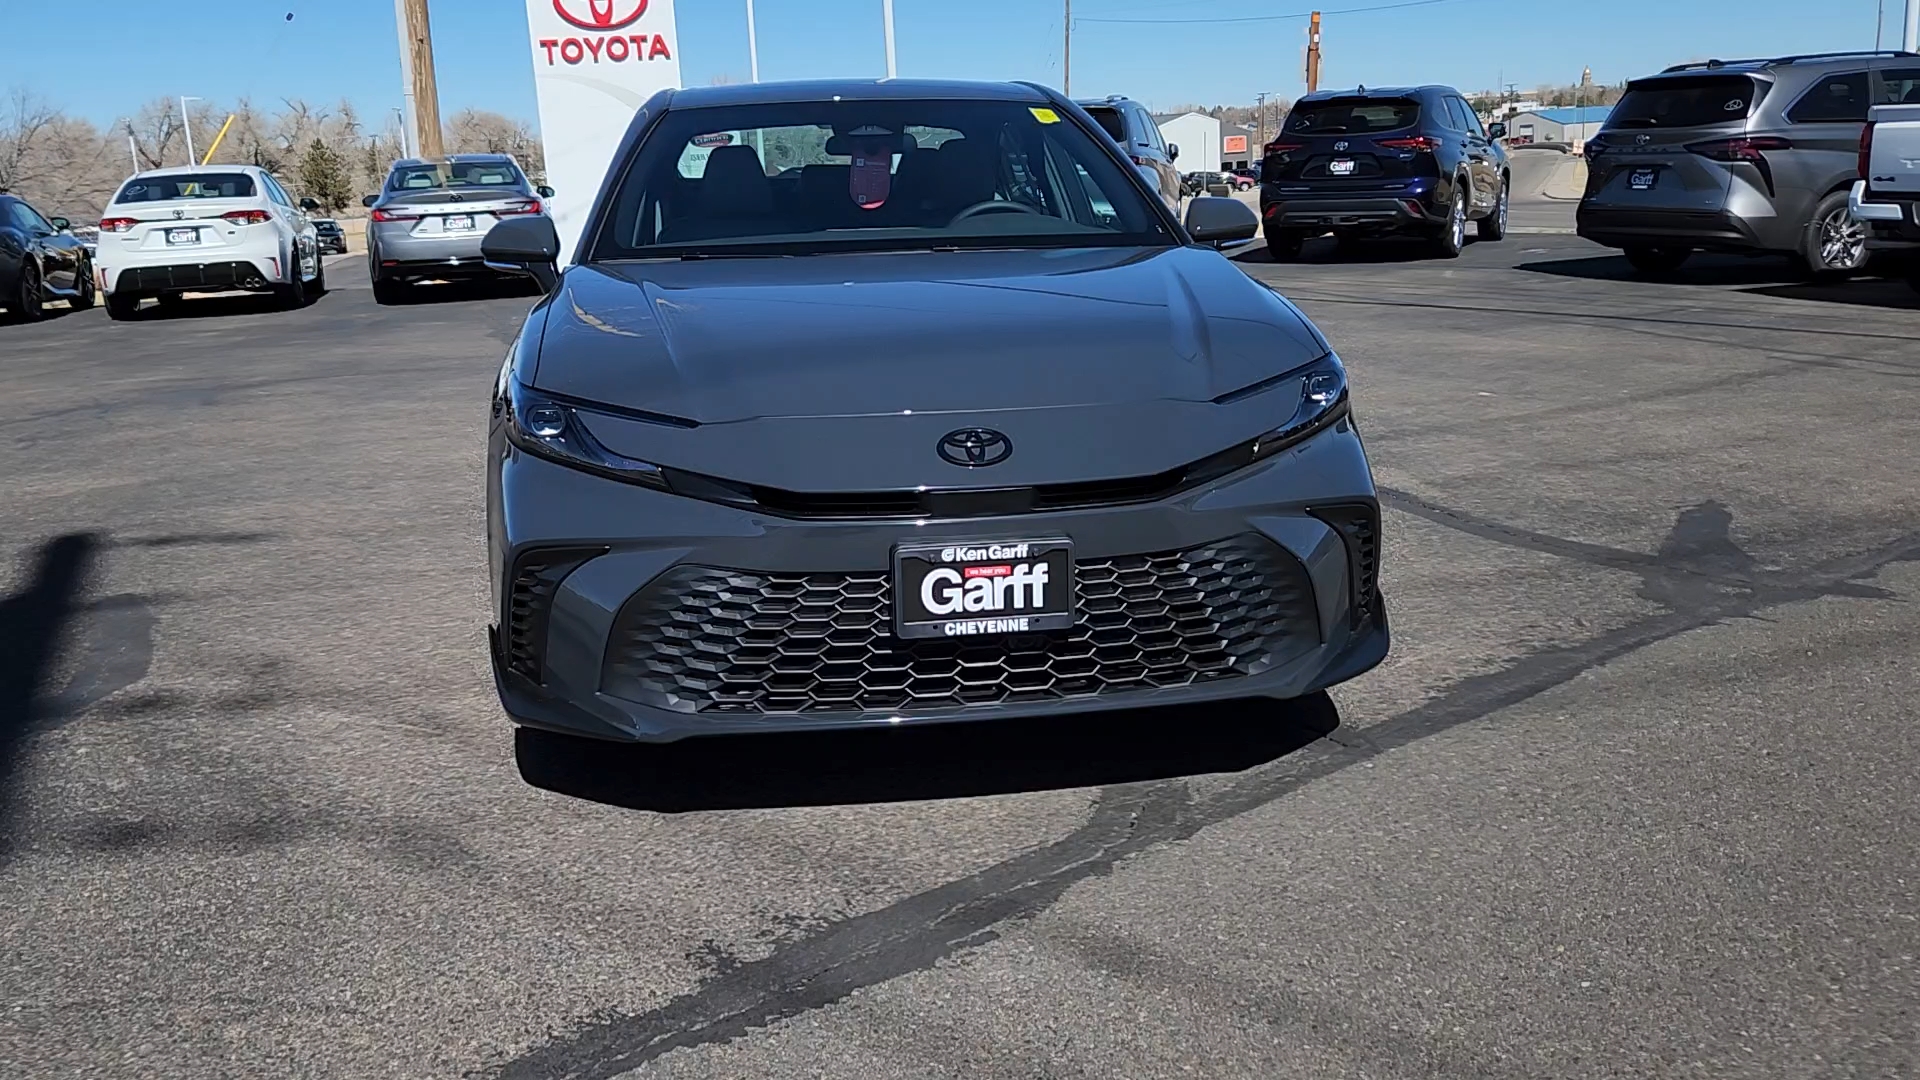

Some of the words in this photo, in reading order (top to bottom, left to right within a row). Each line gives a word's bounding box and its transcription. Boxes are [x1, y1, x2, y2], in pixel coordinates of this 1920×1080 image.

[539, 34, 671, 66] TOYOTA
[1330, 160, 1354, 172] Garff
[1631, 173, 1655, 185] Garff
[446, 217, 472, 229] Garff
[169, 230, 197, 243] Garff
[956, 547, 987, 561] Ken
[988, 544, 1029, 560] Garff
[921, 562, 1049, 615] Garff
[944, 618, 1029, 636] CHEYENNE
